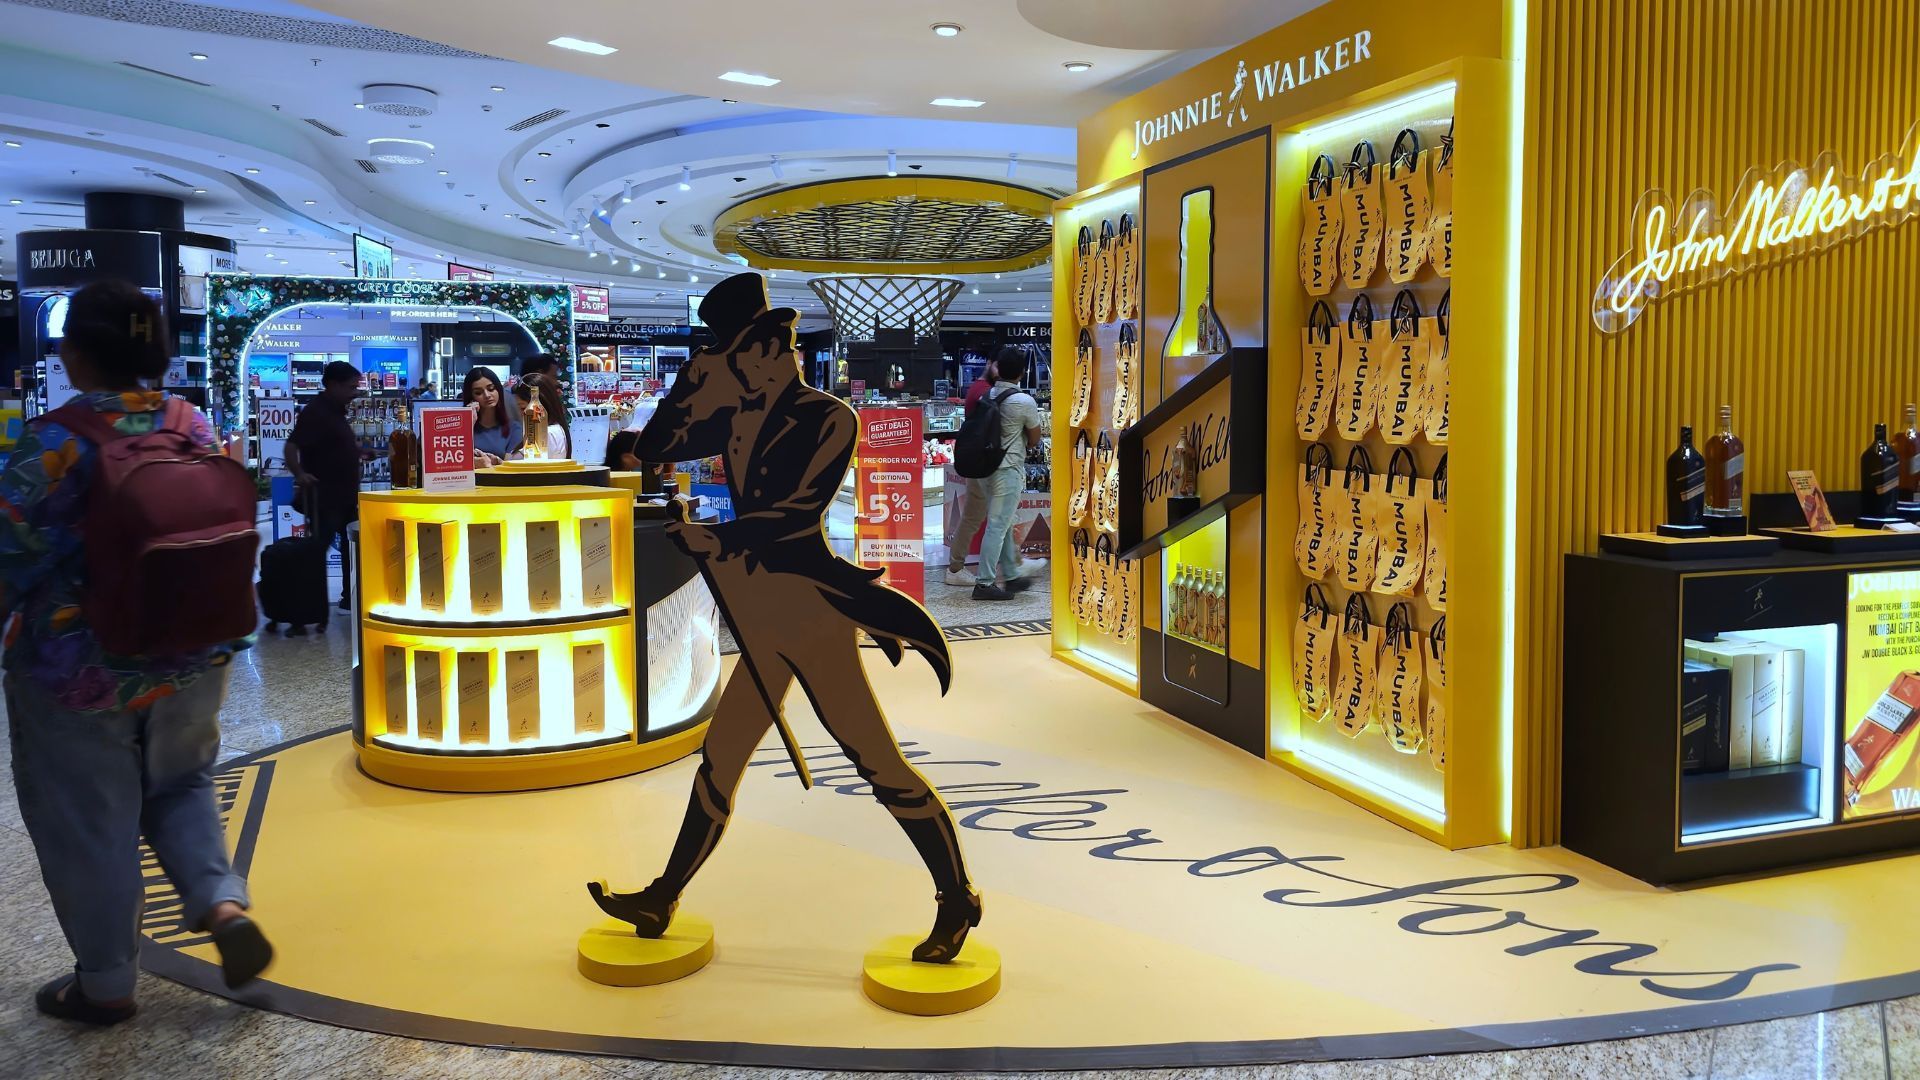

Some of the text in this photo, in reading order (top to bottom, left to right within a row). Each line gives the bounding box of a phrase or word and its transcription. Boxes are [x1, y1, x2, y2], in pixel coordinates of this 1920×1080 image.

[1130, 29, 1372, 160] JOHNNIE WALKER
[30, 248, 96, 270] BELUGA
[1312, 205, 1329, 288] MUMBAI
[1352, 193, 1370, 281] MUMBAI
[1399, 183, 1416, 275] MUMBAI
[1611, 205, 1726, 313] John
[357, 282, 389, 293] GREY
[1078, 261, 1089, 321] MUMBAI
[1098, 256, 1110, 318] MUMBAI
[1121, 250, 1131, 314] MUMBAI
[391, 310, 436, 318] PRE-ORDER
[584, 324, 611, 332] MALT
[614, 325, 677, 334] COLLECTION
[1007, 326, 1037, 337] LUXE
[261, 409, 292, 426] 200
[1074, 364, 1088, 422] MUMBAI
[1117, 361, 1129, 424] MUMBAI
[1304, 351, 1325, 433] MUMBAI
[1348, 346, 1369, 432] MUMBAI
[1391, 345, 1412, 436] MUMBAI
[433, 435, 465, 448] FREE
[434, 449, 465, 465] BAG
[870, 420, 910, 432] BEST DEALS
[870, 429, 910, 440] GUARANTEED!
[872, 473, 910, 481] ADDITIONAL
[1308, 490, 1325, 572] MUMBAI
[1347, 497, 1364, 583] MUMBAI
[1381, 501, 1408, 587] MUMBAI
[1076, 561, 1089, 620] MUMBAI
[1096, 569, 1109, 628] MUMBAI
[1117, 575, 1130, 639] MUMBAI
[1868, 623, 1897, 636] MUMBAI
[1898, 621, 1913, 634] GIFT
[1304, 631, 1317, 713] MUMBAI
[1344, 644, 1363, 729] MUMBAI
[1391, 655, 1408, 747] MUMBAI
